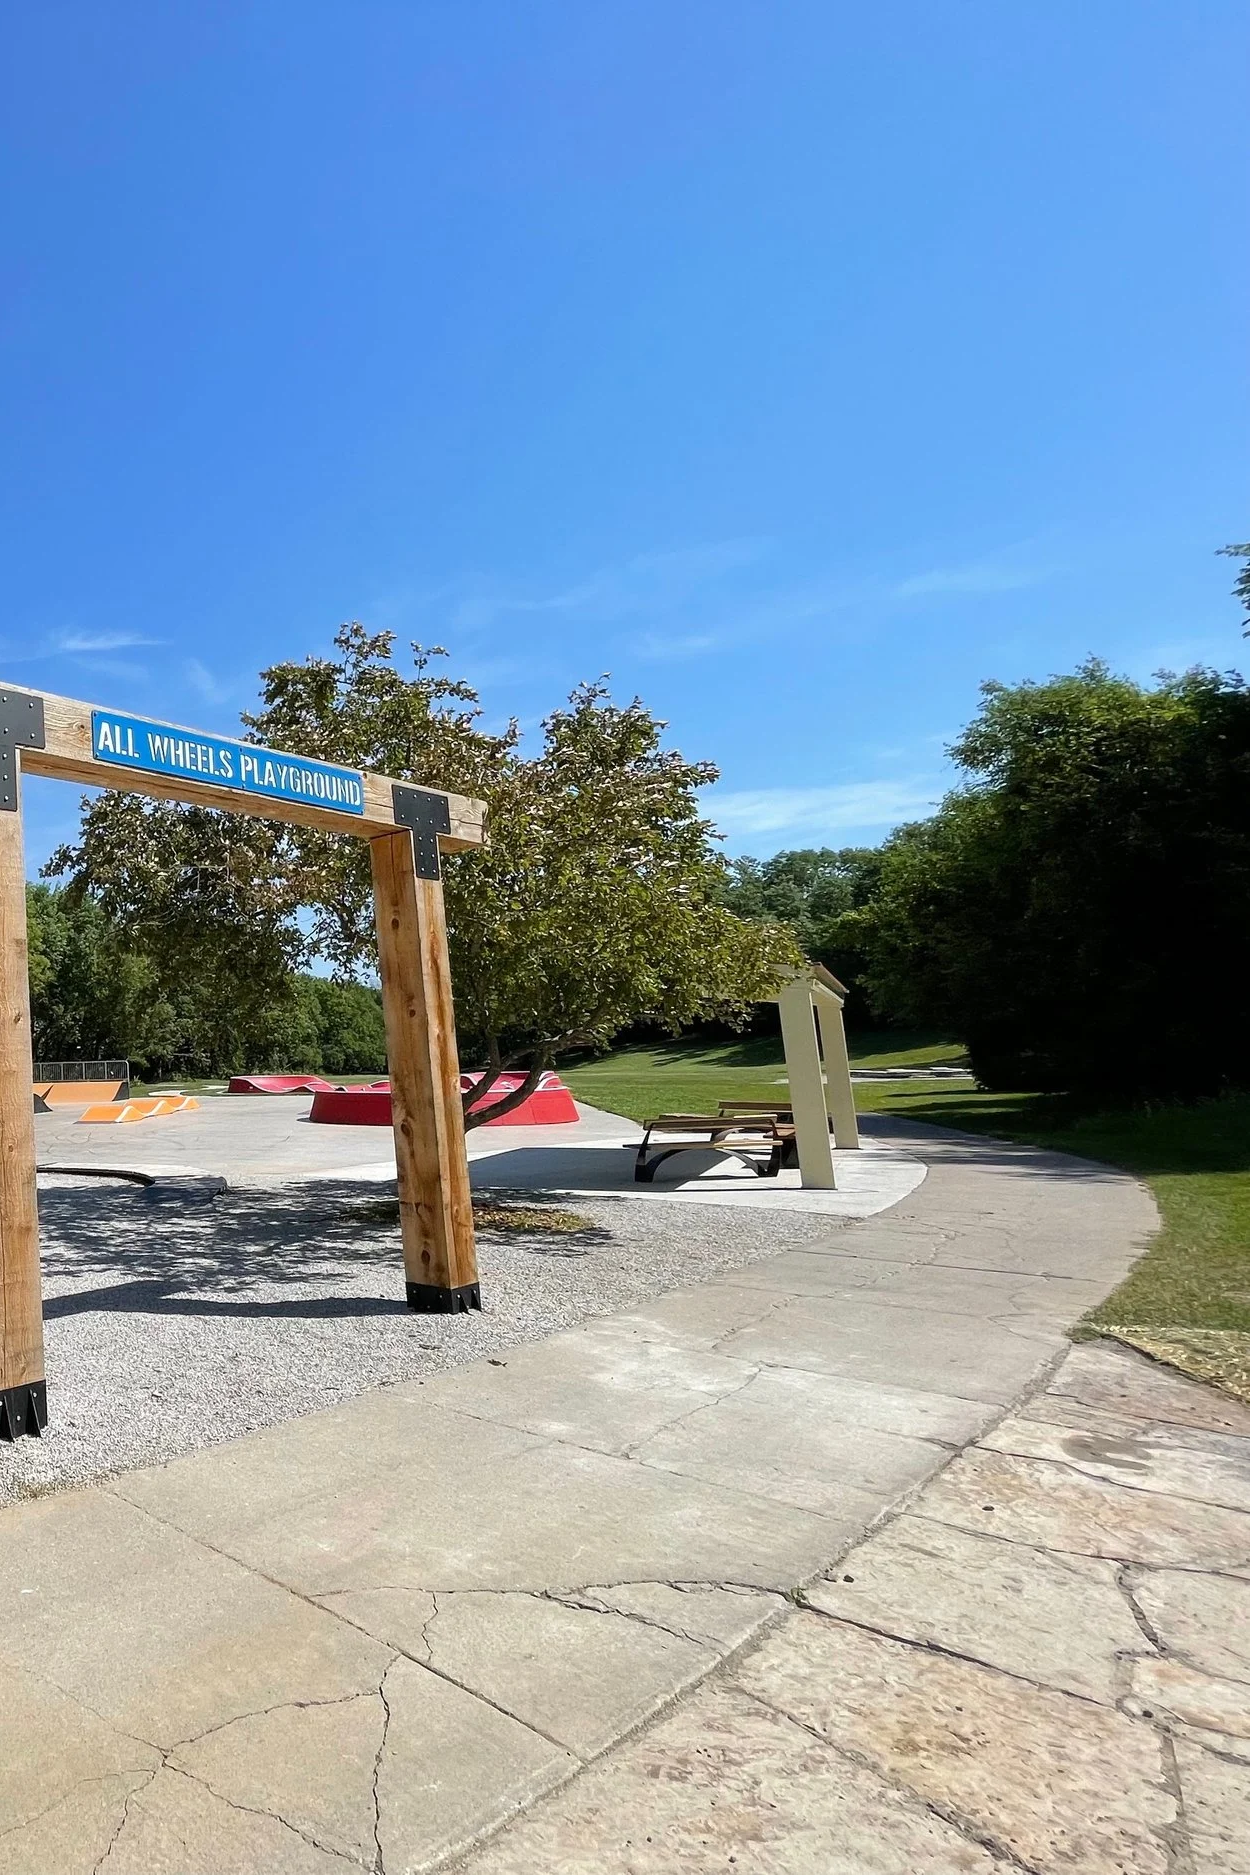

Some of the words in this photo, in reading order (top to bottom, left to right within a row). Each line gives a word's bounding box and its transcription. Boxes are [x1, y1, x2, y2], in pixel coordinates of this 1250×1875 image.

[98, 721, 140, 759] ALL
[147, 732, 234, 779] WHEELS
[239, 754, 361, 806] PLAYGROUND
